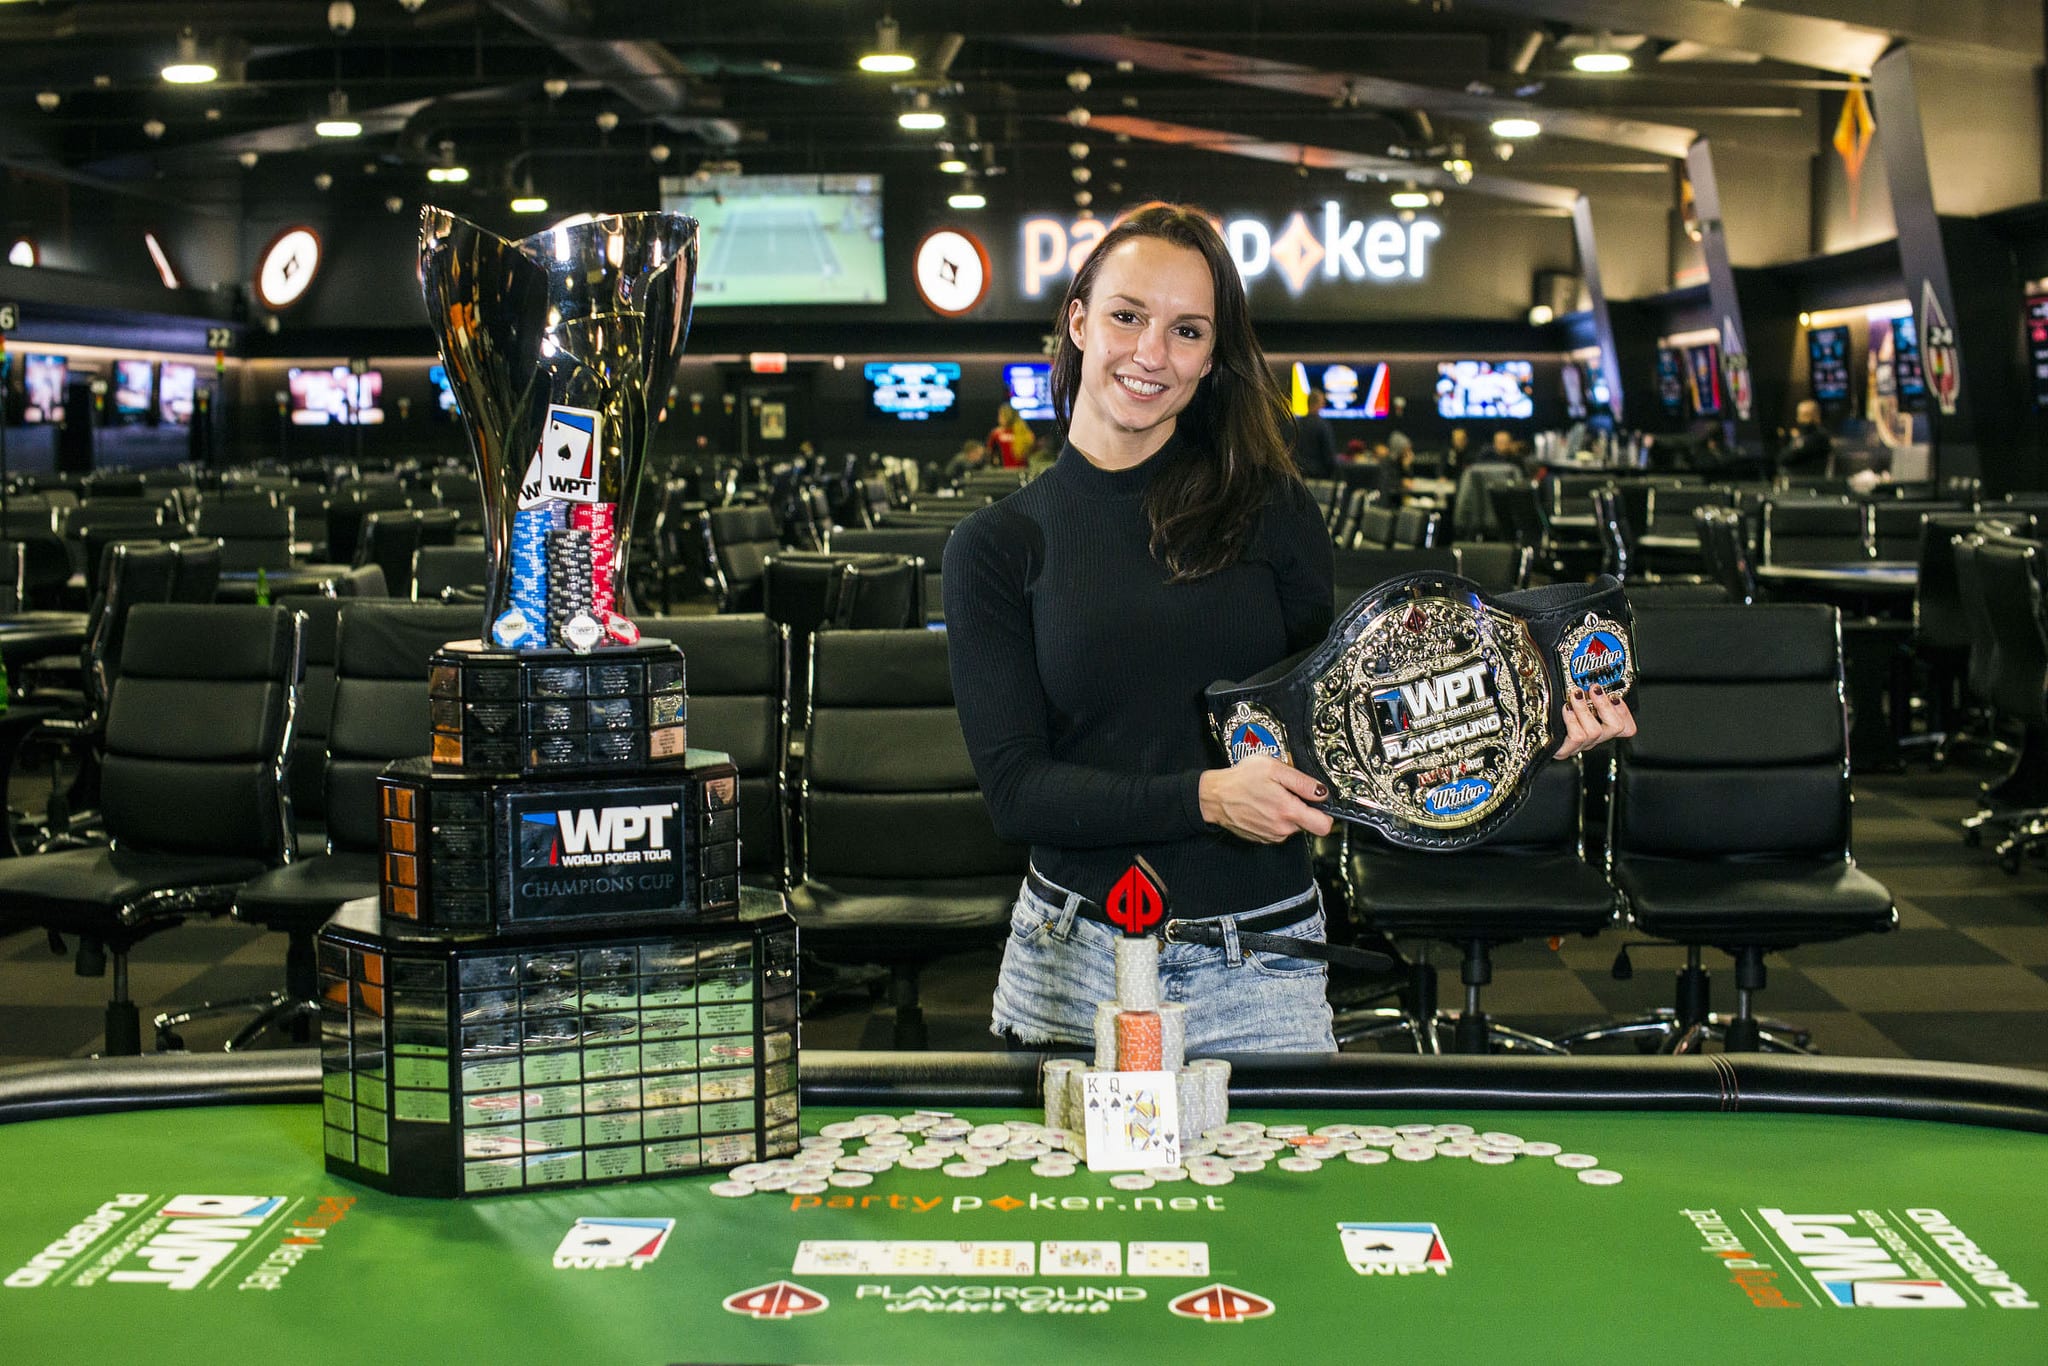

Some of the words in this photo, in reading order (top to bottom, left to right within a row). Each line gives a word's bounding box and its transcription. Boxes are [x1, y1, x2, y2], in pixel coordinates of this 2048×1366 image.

[1024, 201, 1440, 296] papoker
[208, 328, 231, 348] 22
[549, 475, 591, 496] WPT
[1573, 650, 1622, 675] Winter
[1401, 663, 1487, 719] WPT
[1445, 705, 1472, 720] POKER
[1382, 713, 1501, 762] PLAYGROUND
[1432, 784, 1486, 809] Winter
[558, 804, 673, 854] WPT
[562, 854, 602, 867] WORLD
[605, 852, 640, 865] POKER
[643, 850, 672, 861] TOUR
[521, 876, 635, 898] CHAMPIONS
[639, 874, 675, 890] CUP
[1088, 1077, 1098, 1094] K
[1110, 1077, 1121, 1094] Q
[106, 1216, 267, 1290] WPT
[1757, 1208, 1908, 1280] WPT
[856, 1284, 1148, 1301] PLAYGROUND
